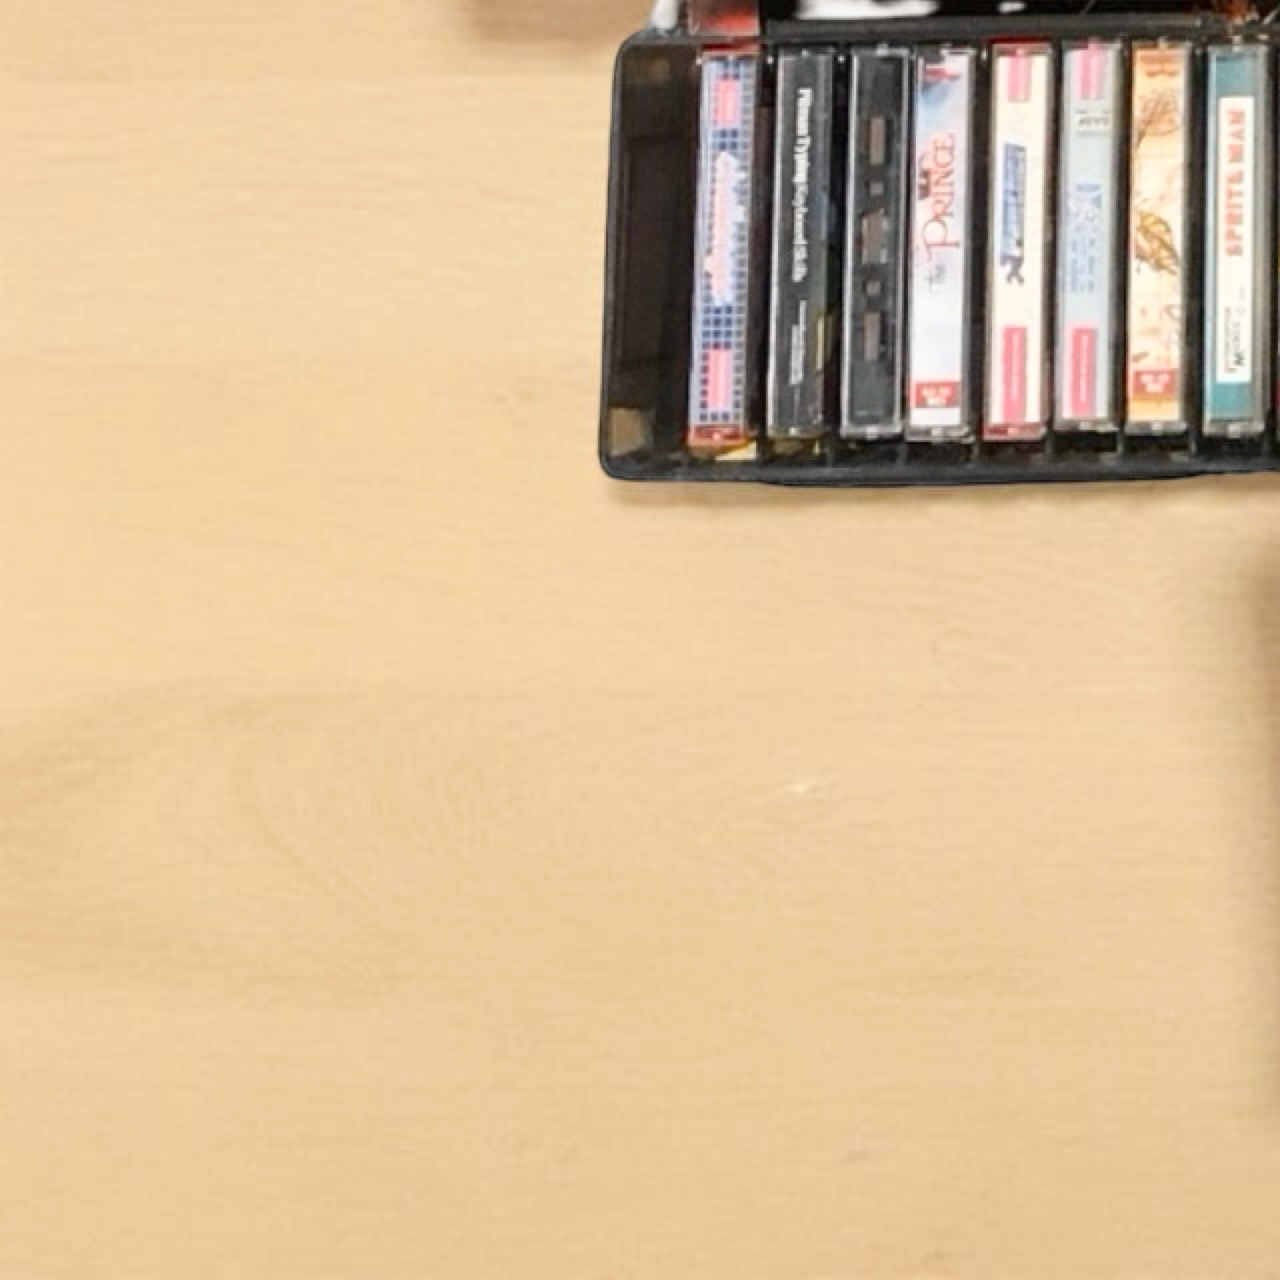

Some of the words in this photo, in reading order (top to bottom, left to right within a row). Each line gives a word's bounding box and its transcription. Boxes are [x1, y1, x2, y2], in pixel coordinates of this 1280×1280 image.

[1224, 109, 1245, 164] MAN
[920, 131, 961, 260] PRINCE
[1222, 170, 1245, 257] SPRITE
